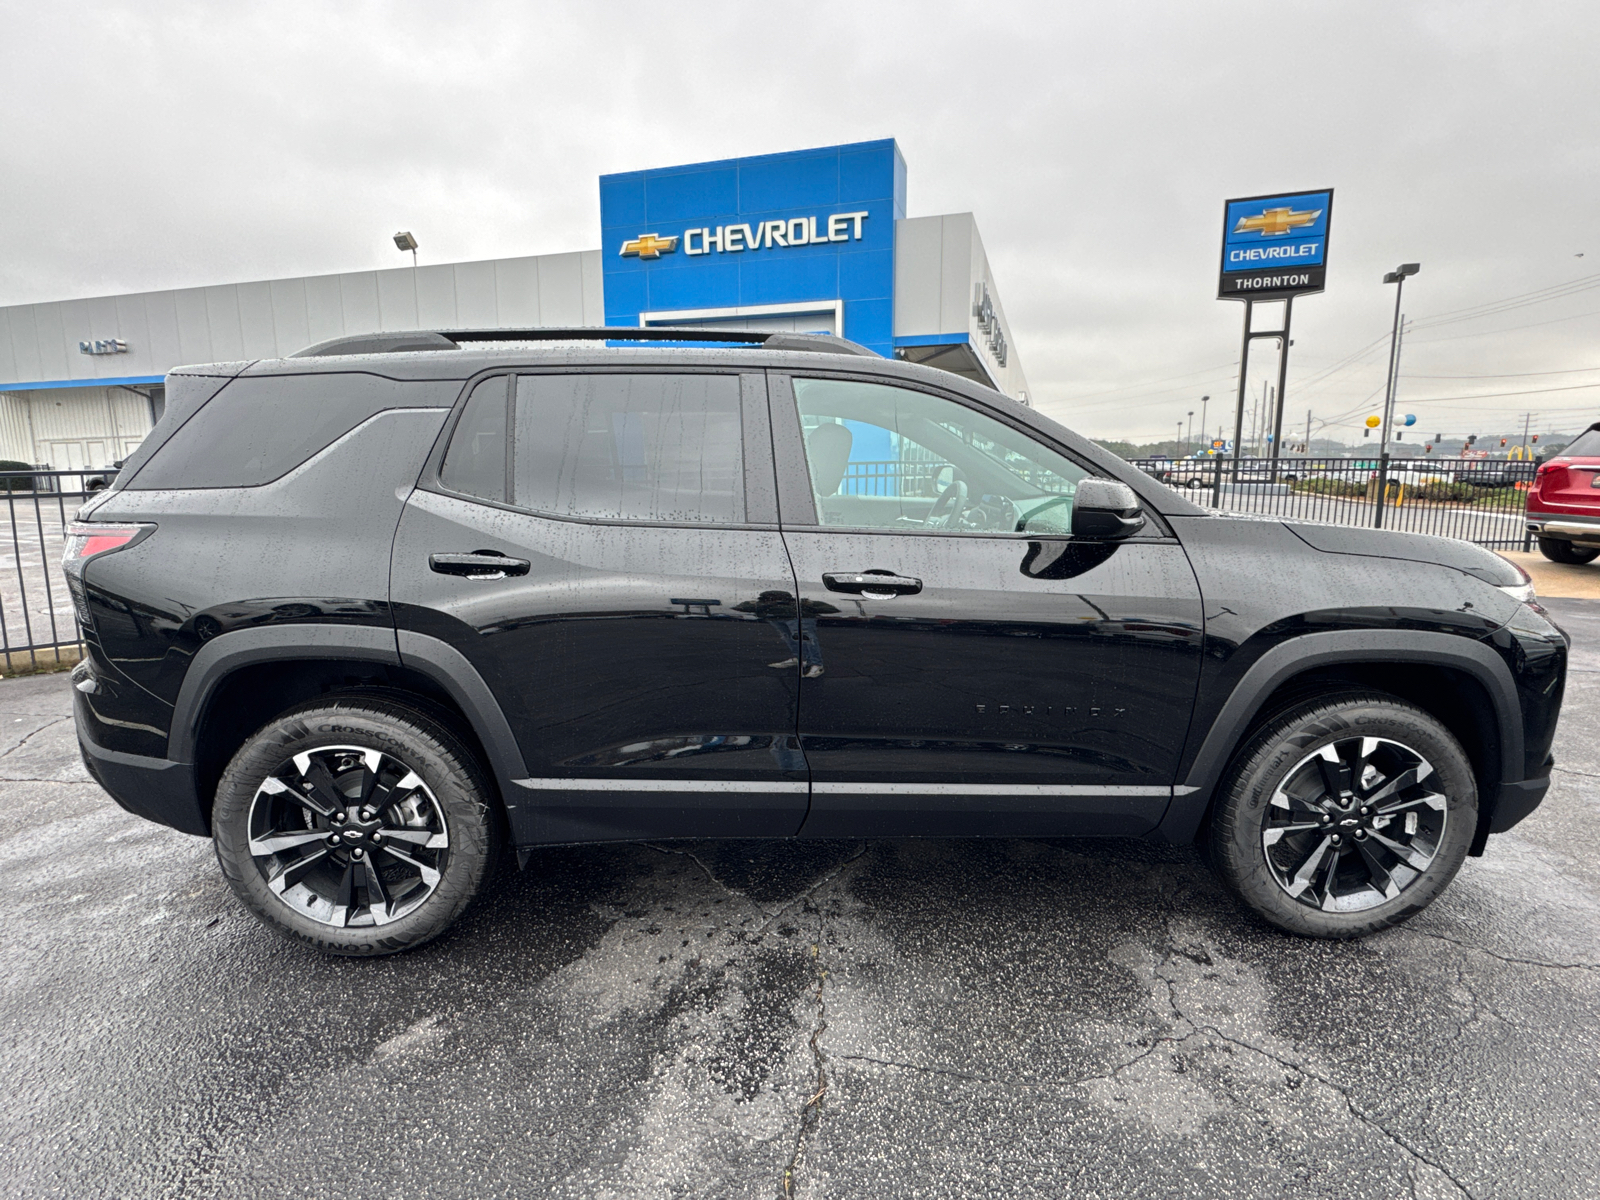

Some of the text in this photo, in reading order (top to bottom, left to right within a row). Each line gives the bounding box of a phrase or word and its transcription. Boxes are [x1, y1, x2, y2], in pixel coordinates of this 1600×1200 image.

[684, 211, 869, 256] CHEVROLET
[1230, 243, 1319, 262] CHEVROLET
[1235, 273, 1310, 289] THORNTON
[79, 338, 127, 355] PARTS
